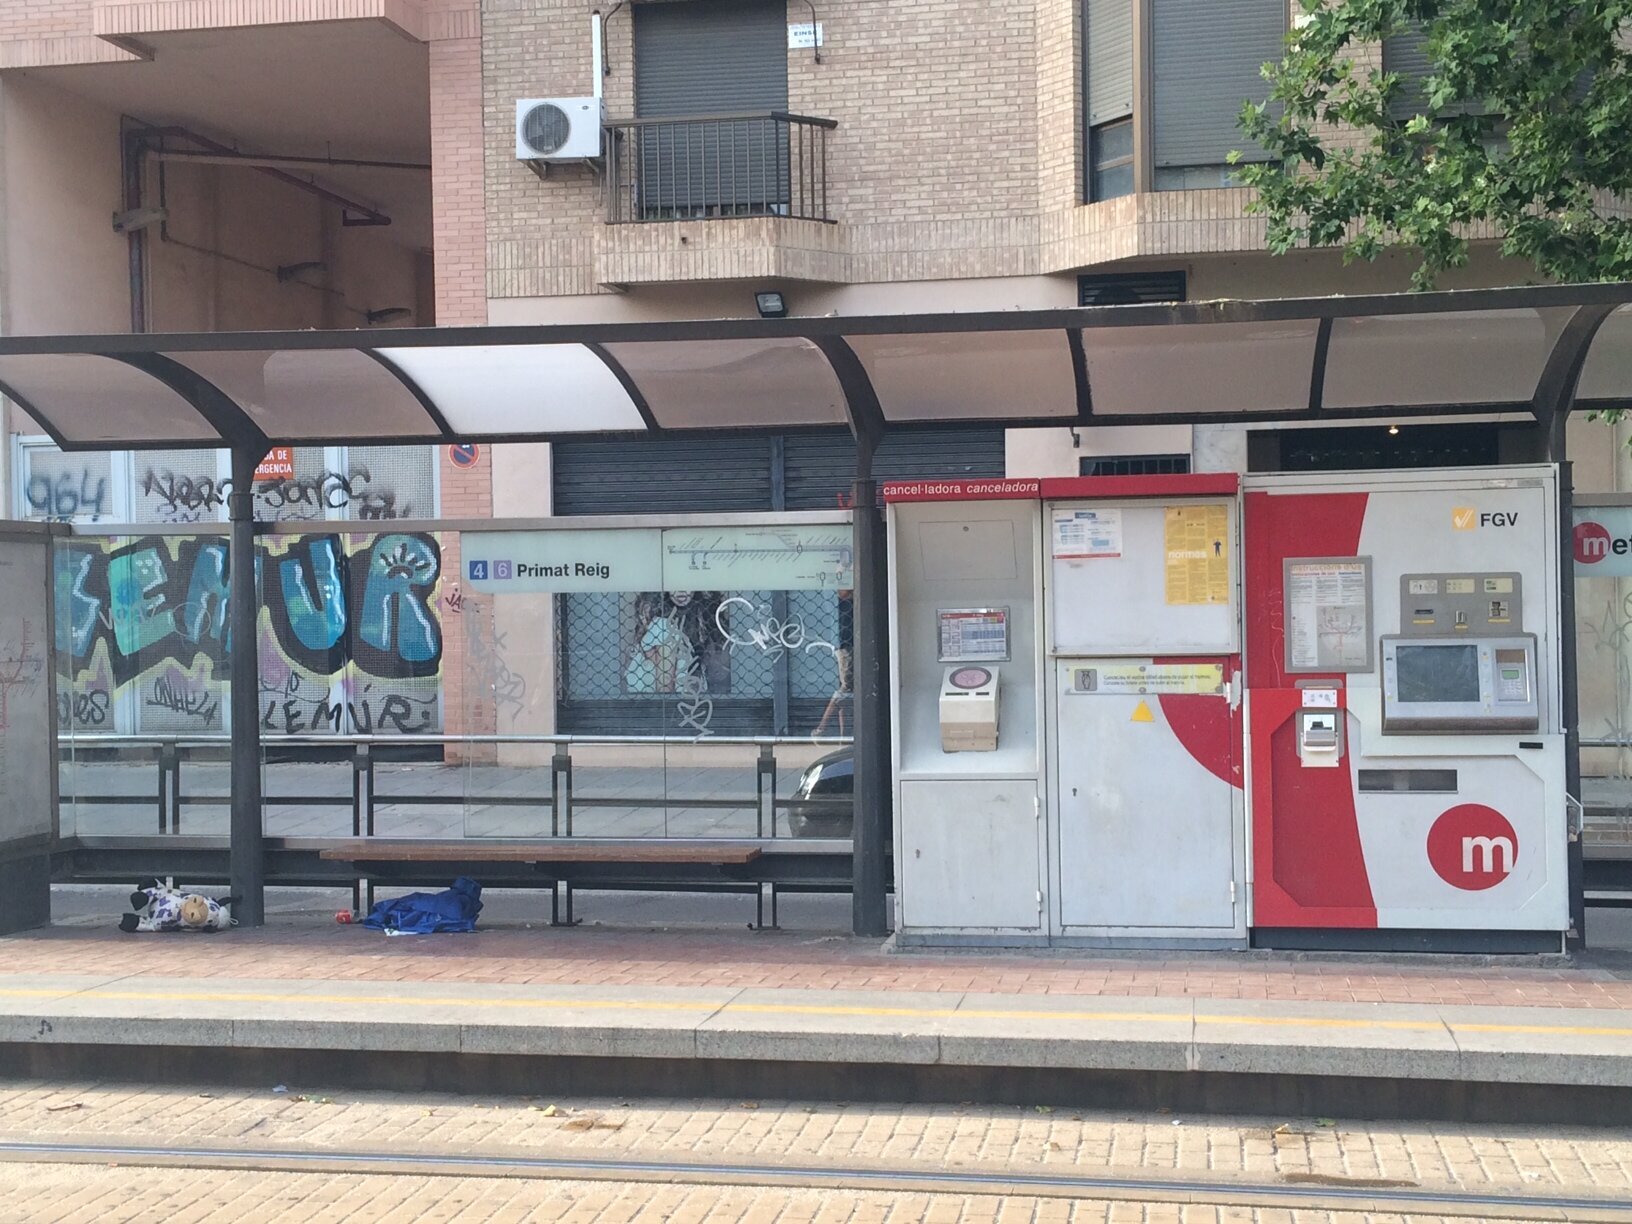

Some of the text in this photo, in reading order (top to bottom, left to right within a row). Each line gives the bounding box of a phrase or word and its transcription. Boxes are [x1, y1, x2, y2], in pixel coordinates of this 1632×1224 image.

[277, 450, 288, 460] DE
[966, 482, 1039, 494] canceladora
[1480, 512, 1519, 527] FGV
[473, 562, 610, 579] 4 6 Primat Reig
[1461, 835, 1514, 874] m
